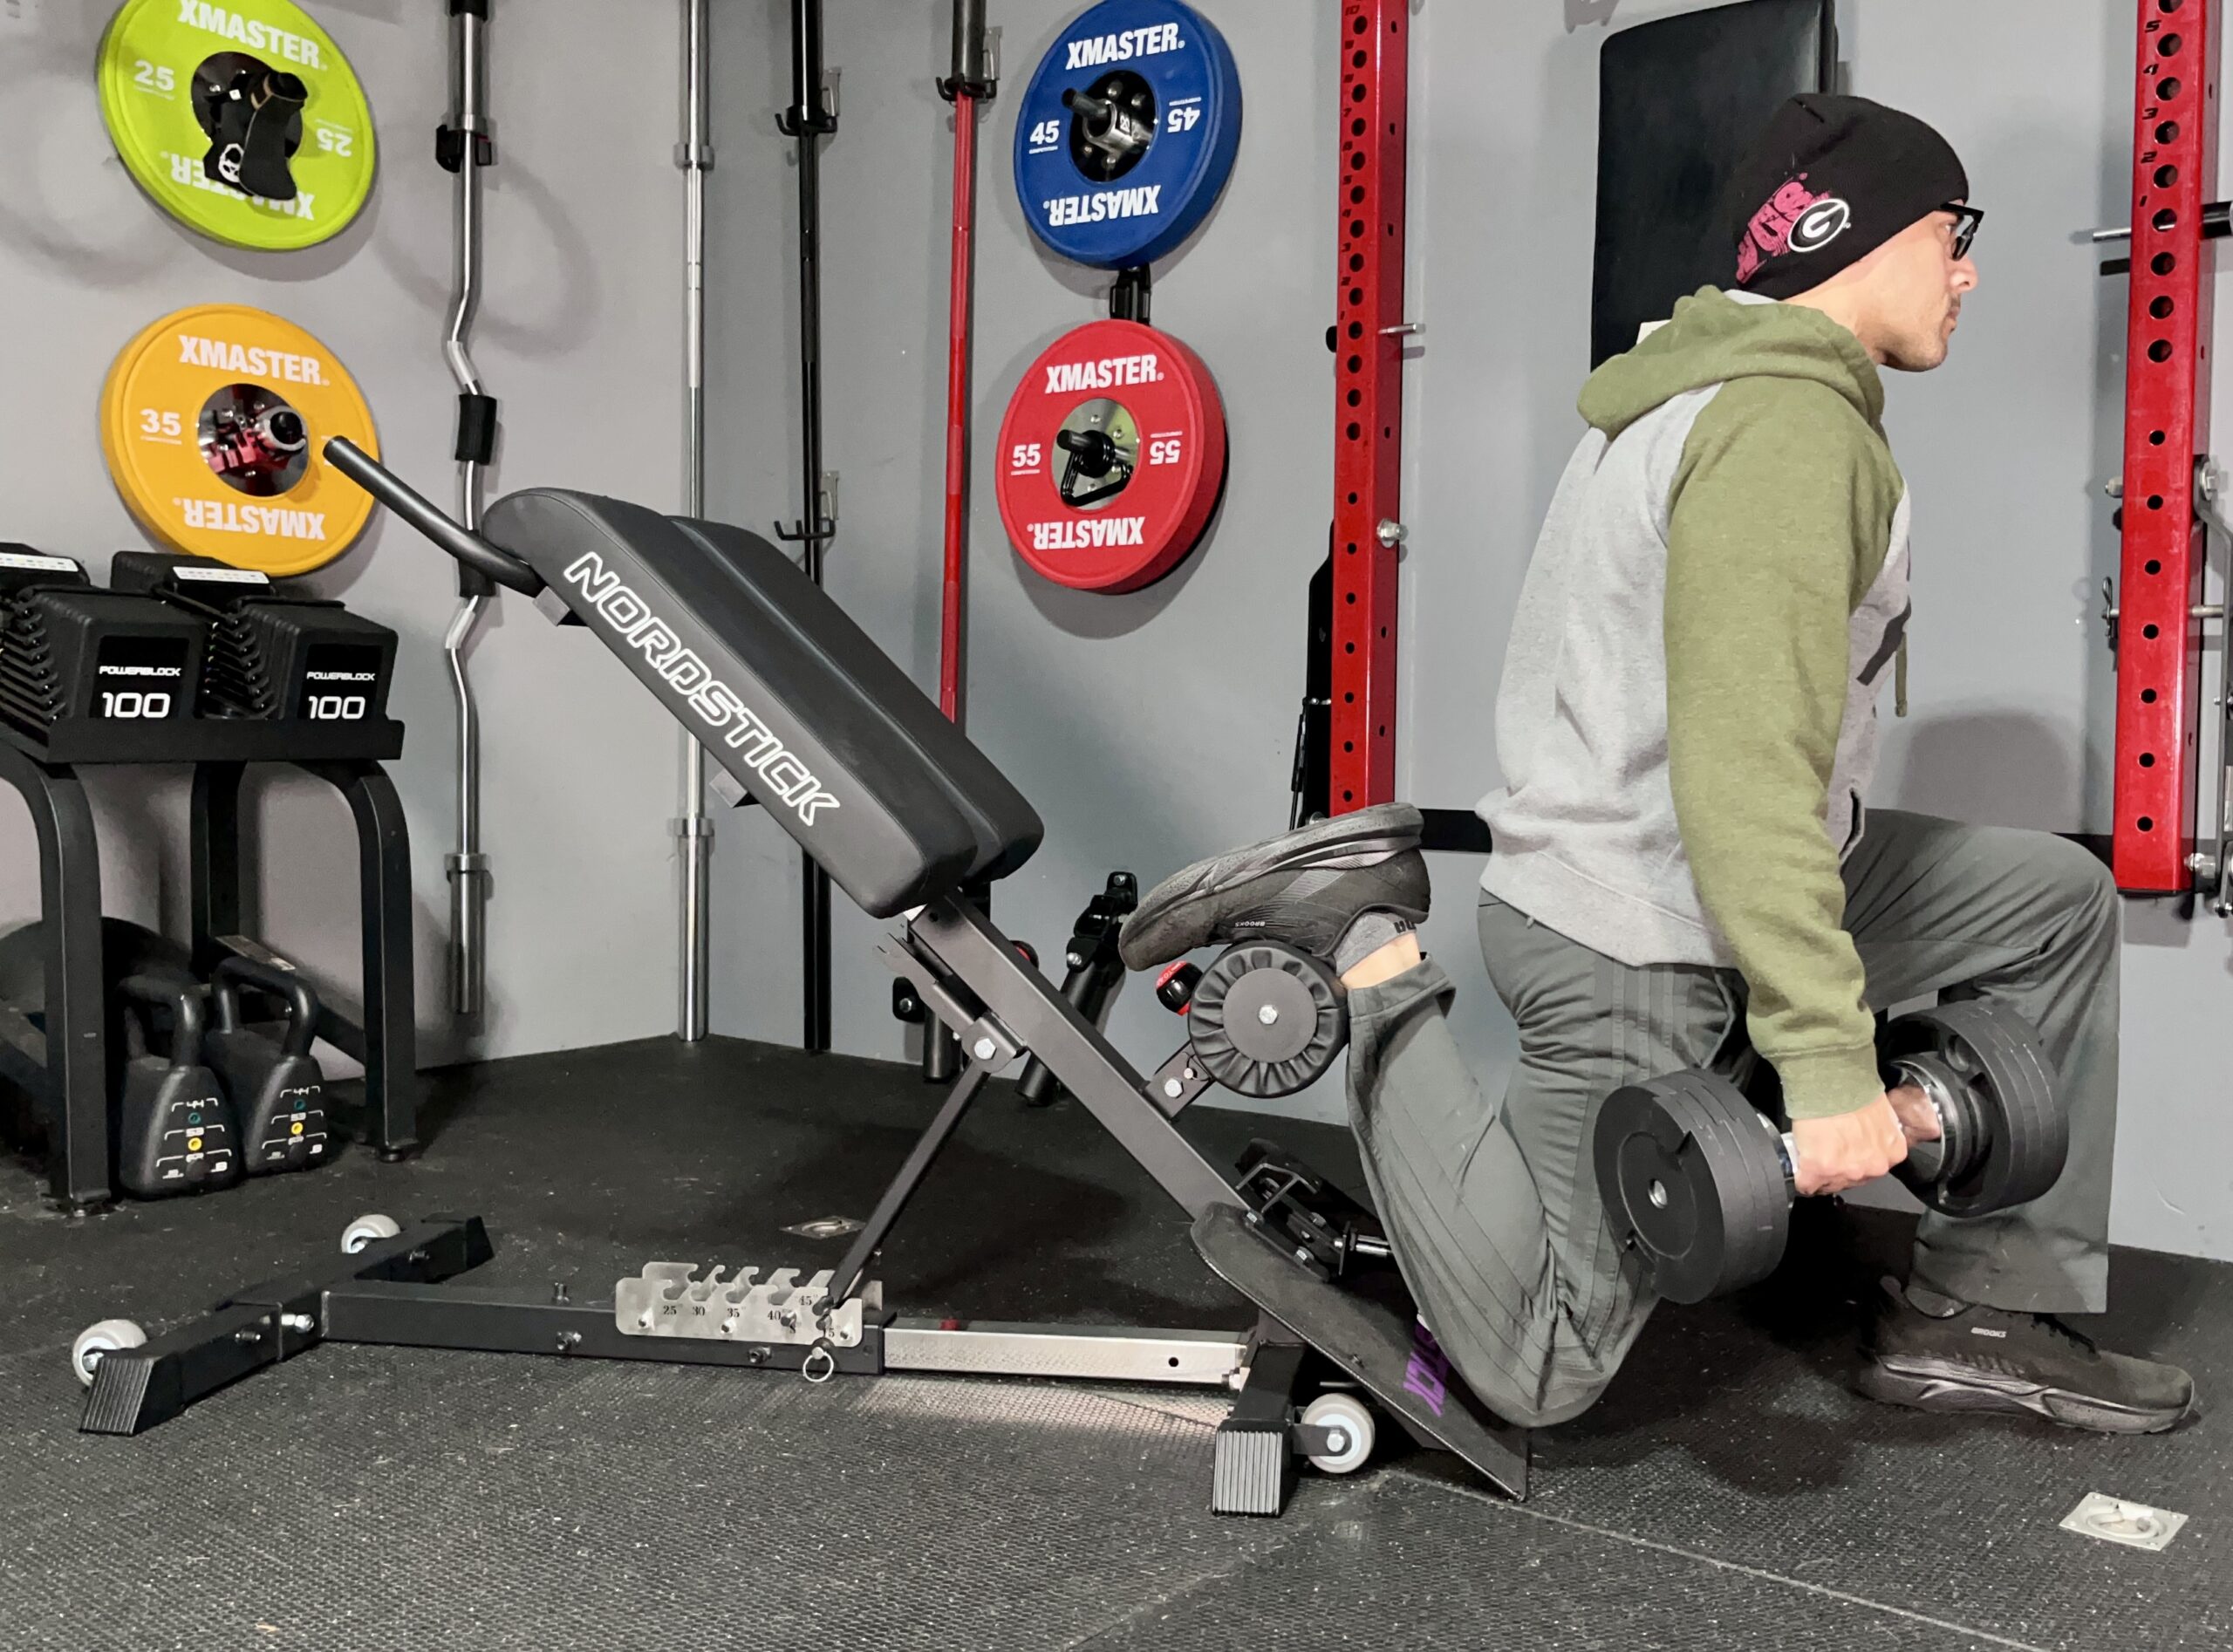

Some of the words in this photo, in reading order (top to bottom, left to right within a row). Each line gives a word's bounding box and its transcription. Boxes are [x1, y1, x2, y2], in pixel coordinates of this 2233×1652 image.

[134, 60, 174, 91] 25
[1167, 106, 1201, 133] 45
[317, 128, 352, 157] 25
[1029, 120, 1060, 146] 45
[140, 408, 181, 436] 35
[1012, 443, 1041, 468] 55
[1150, 440, 1181, 465] 55
[99, 666, 181, 677] POWERBLOCK
[306, 671, 376, 681] POWERBLOCK
[563, 550, 840, 827] NORDSTICK
[102, 692, 171, 719] 100
[308, 695, 365, 720] 100
